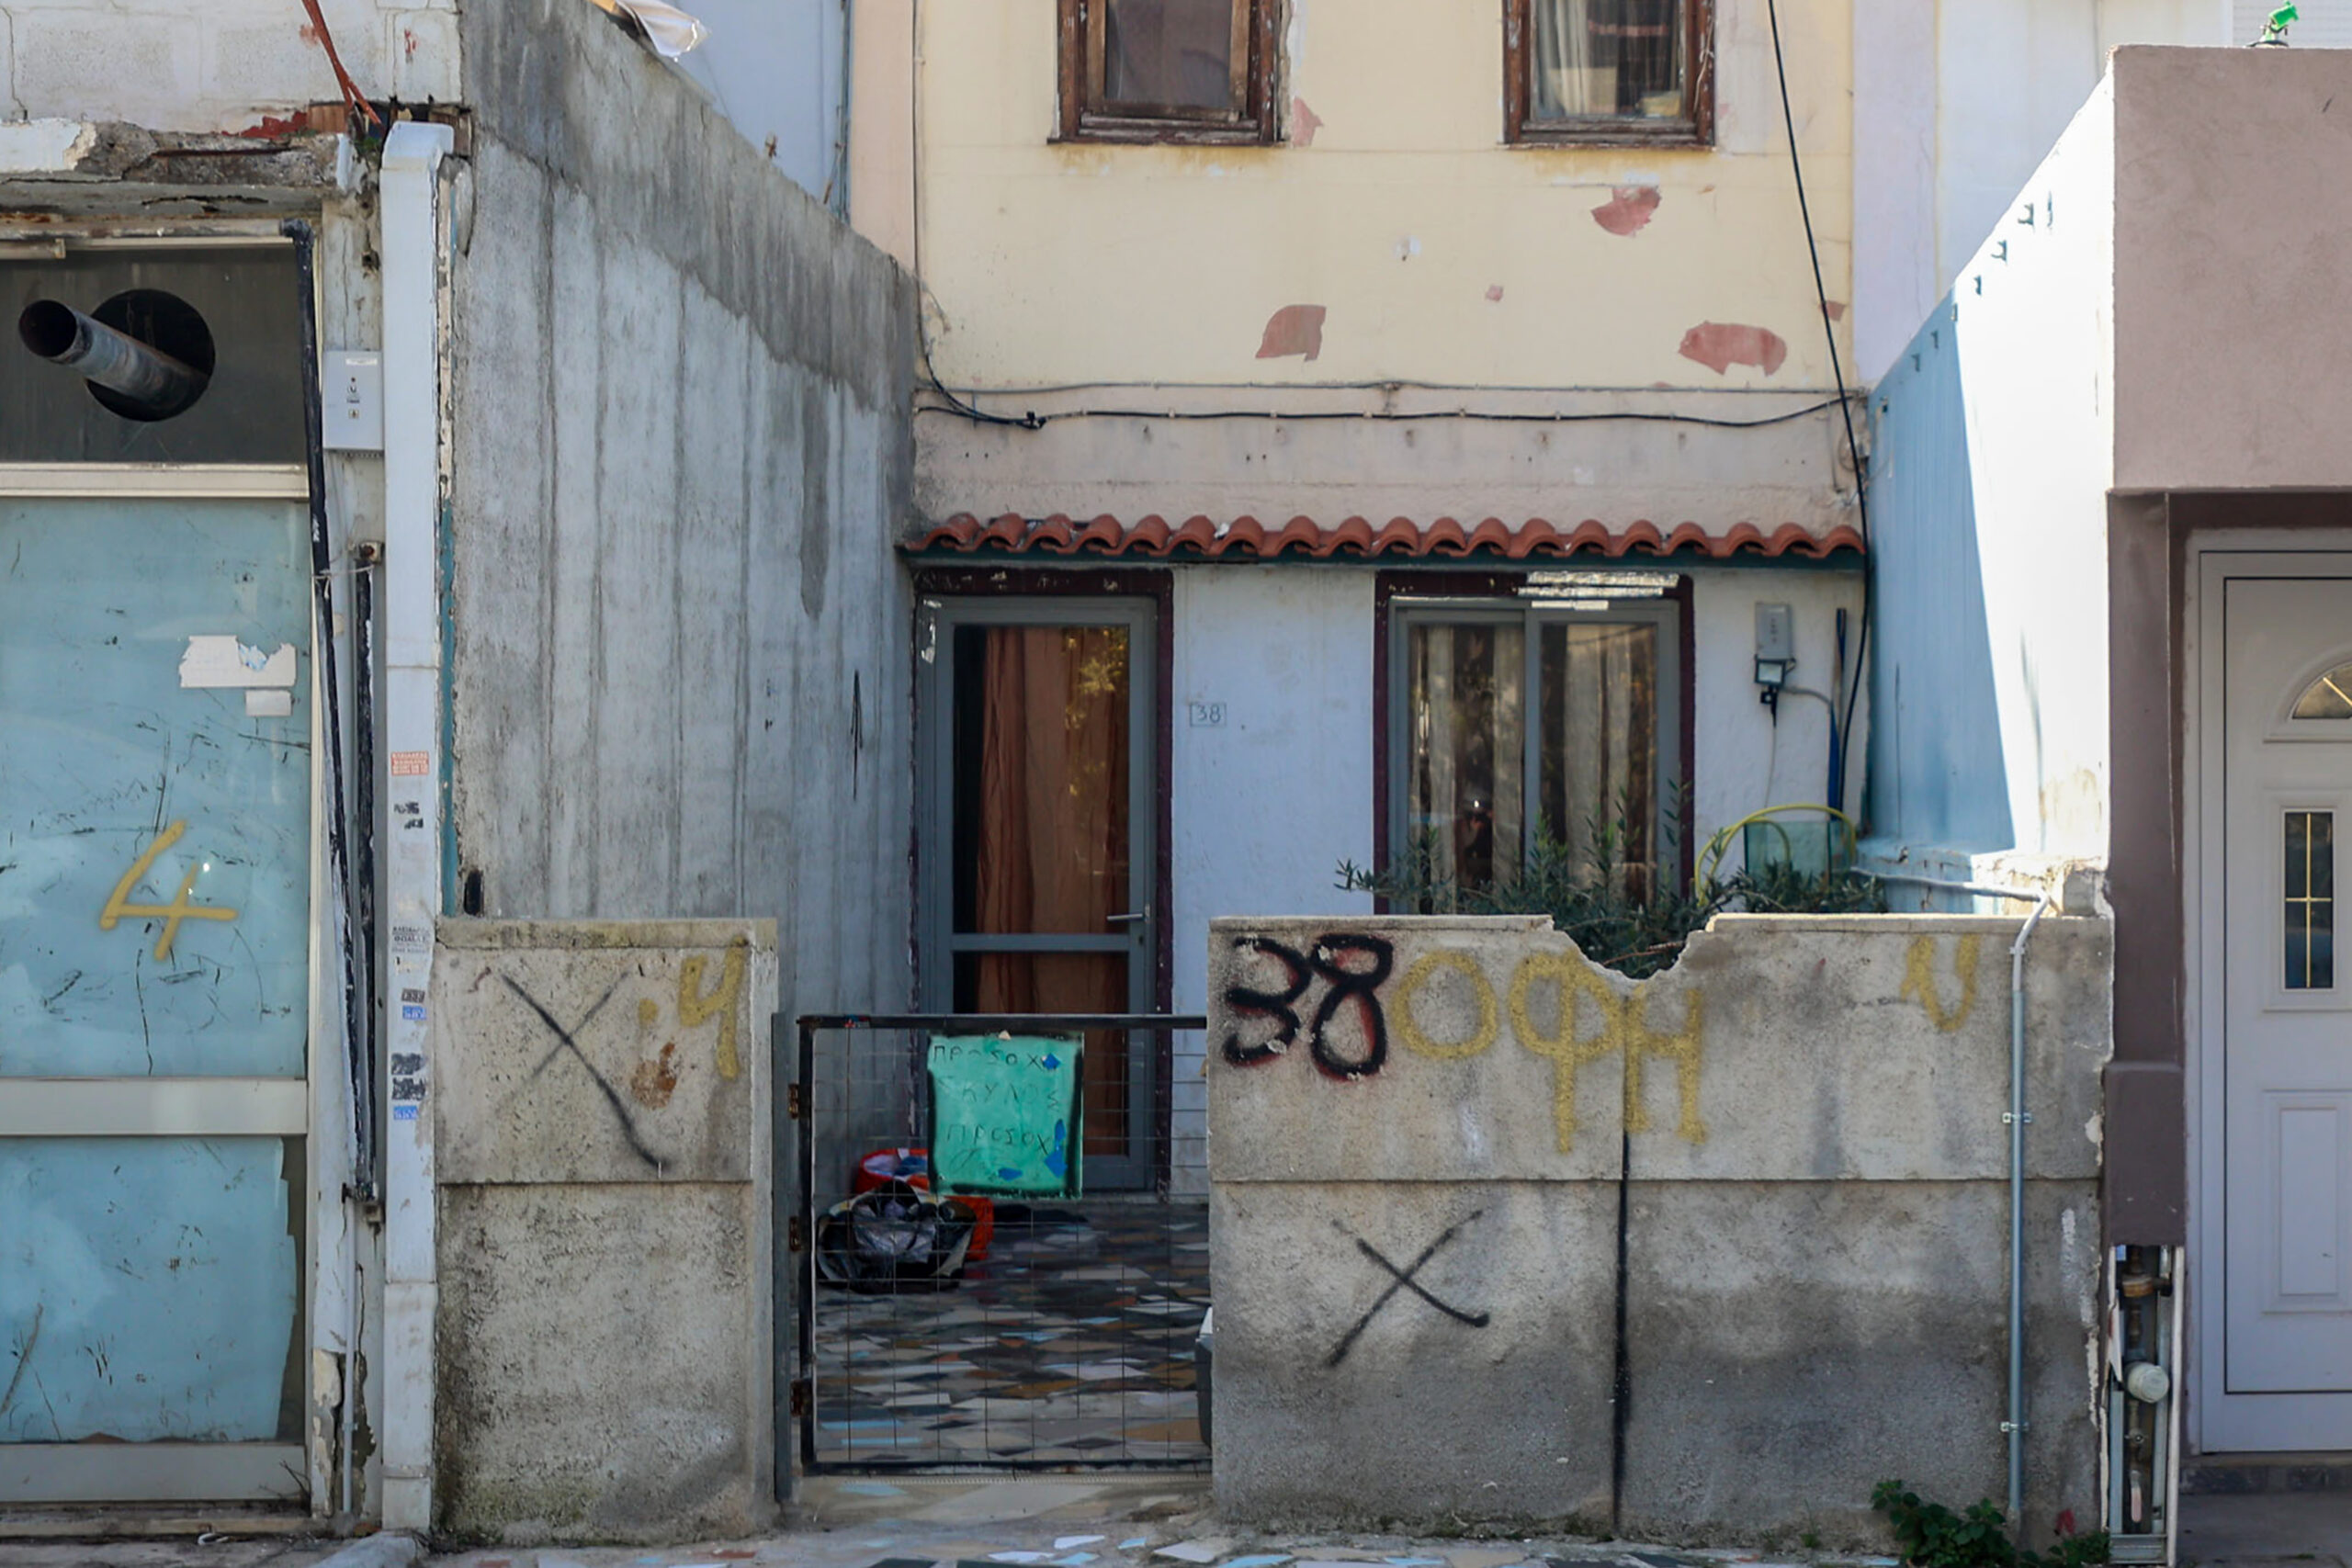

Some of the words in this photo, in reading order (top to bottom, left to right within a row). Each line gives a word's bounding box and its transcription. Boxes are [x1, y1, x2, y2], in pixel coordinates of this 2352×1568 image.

[1198, 704, 1221, 724] 38
[100, 818, 238, 961] 4
[1223, 932, 1394, 1081] 38
[933, 1044, 1061, 1072] ΠΡΟΣΟΧ
[946, 1123, 1052, 1155] ΠΡΟΣΟΧ
